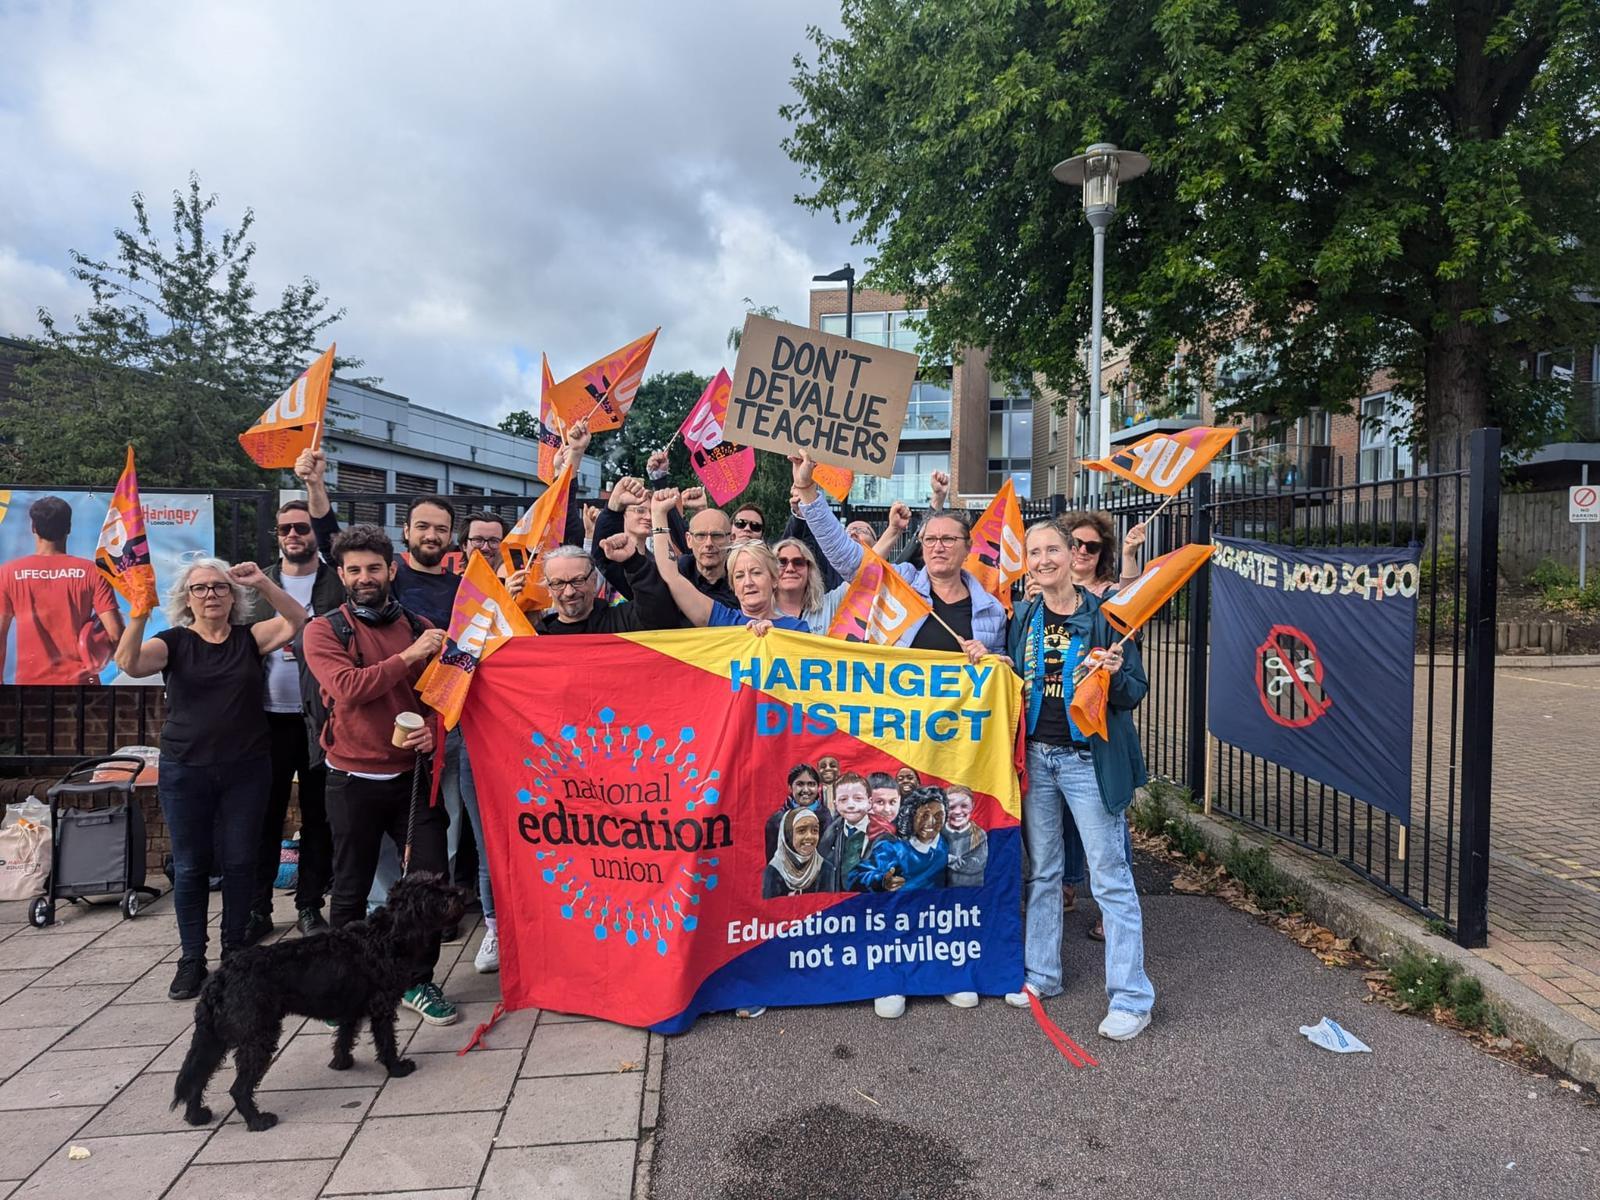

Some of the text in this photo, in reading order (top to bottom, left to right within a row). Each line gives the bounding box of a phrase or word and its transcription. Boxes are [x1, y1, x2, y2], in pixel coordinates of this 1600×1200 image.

[771, 335, 872, 388] DON'T
[745, 367, 887, 429] DEVALUE
[734, 398, 888, 464] TEACHERS
[141, 504, 199, 526] Haringey
[14, 568, 86, 580] LIFEGUARD
[1281, 561, 1338, 595] WOOD
[730, 657, 993, 698] HARINGEY
[756, 702, 992, 742] DISTRICT
[562, 773, 672, 805] national
[518, 799, 733, 852] education
[591, 857, 664, 884] union
[727, 903, 981, 944] Education is a right
[789, 935, 981, 971] not a privilege
